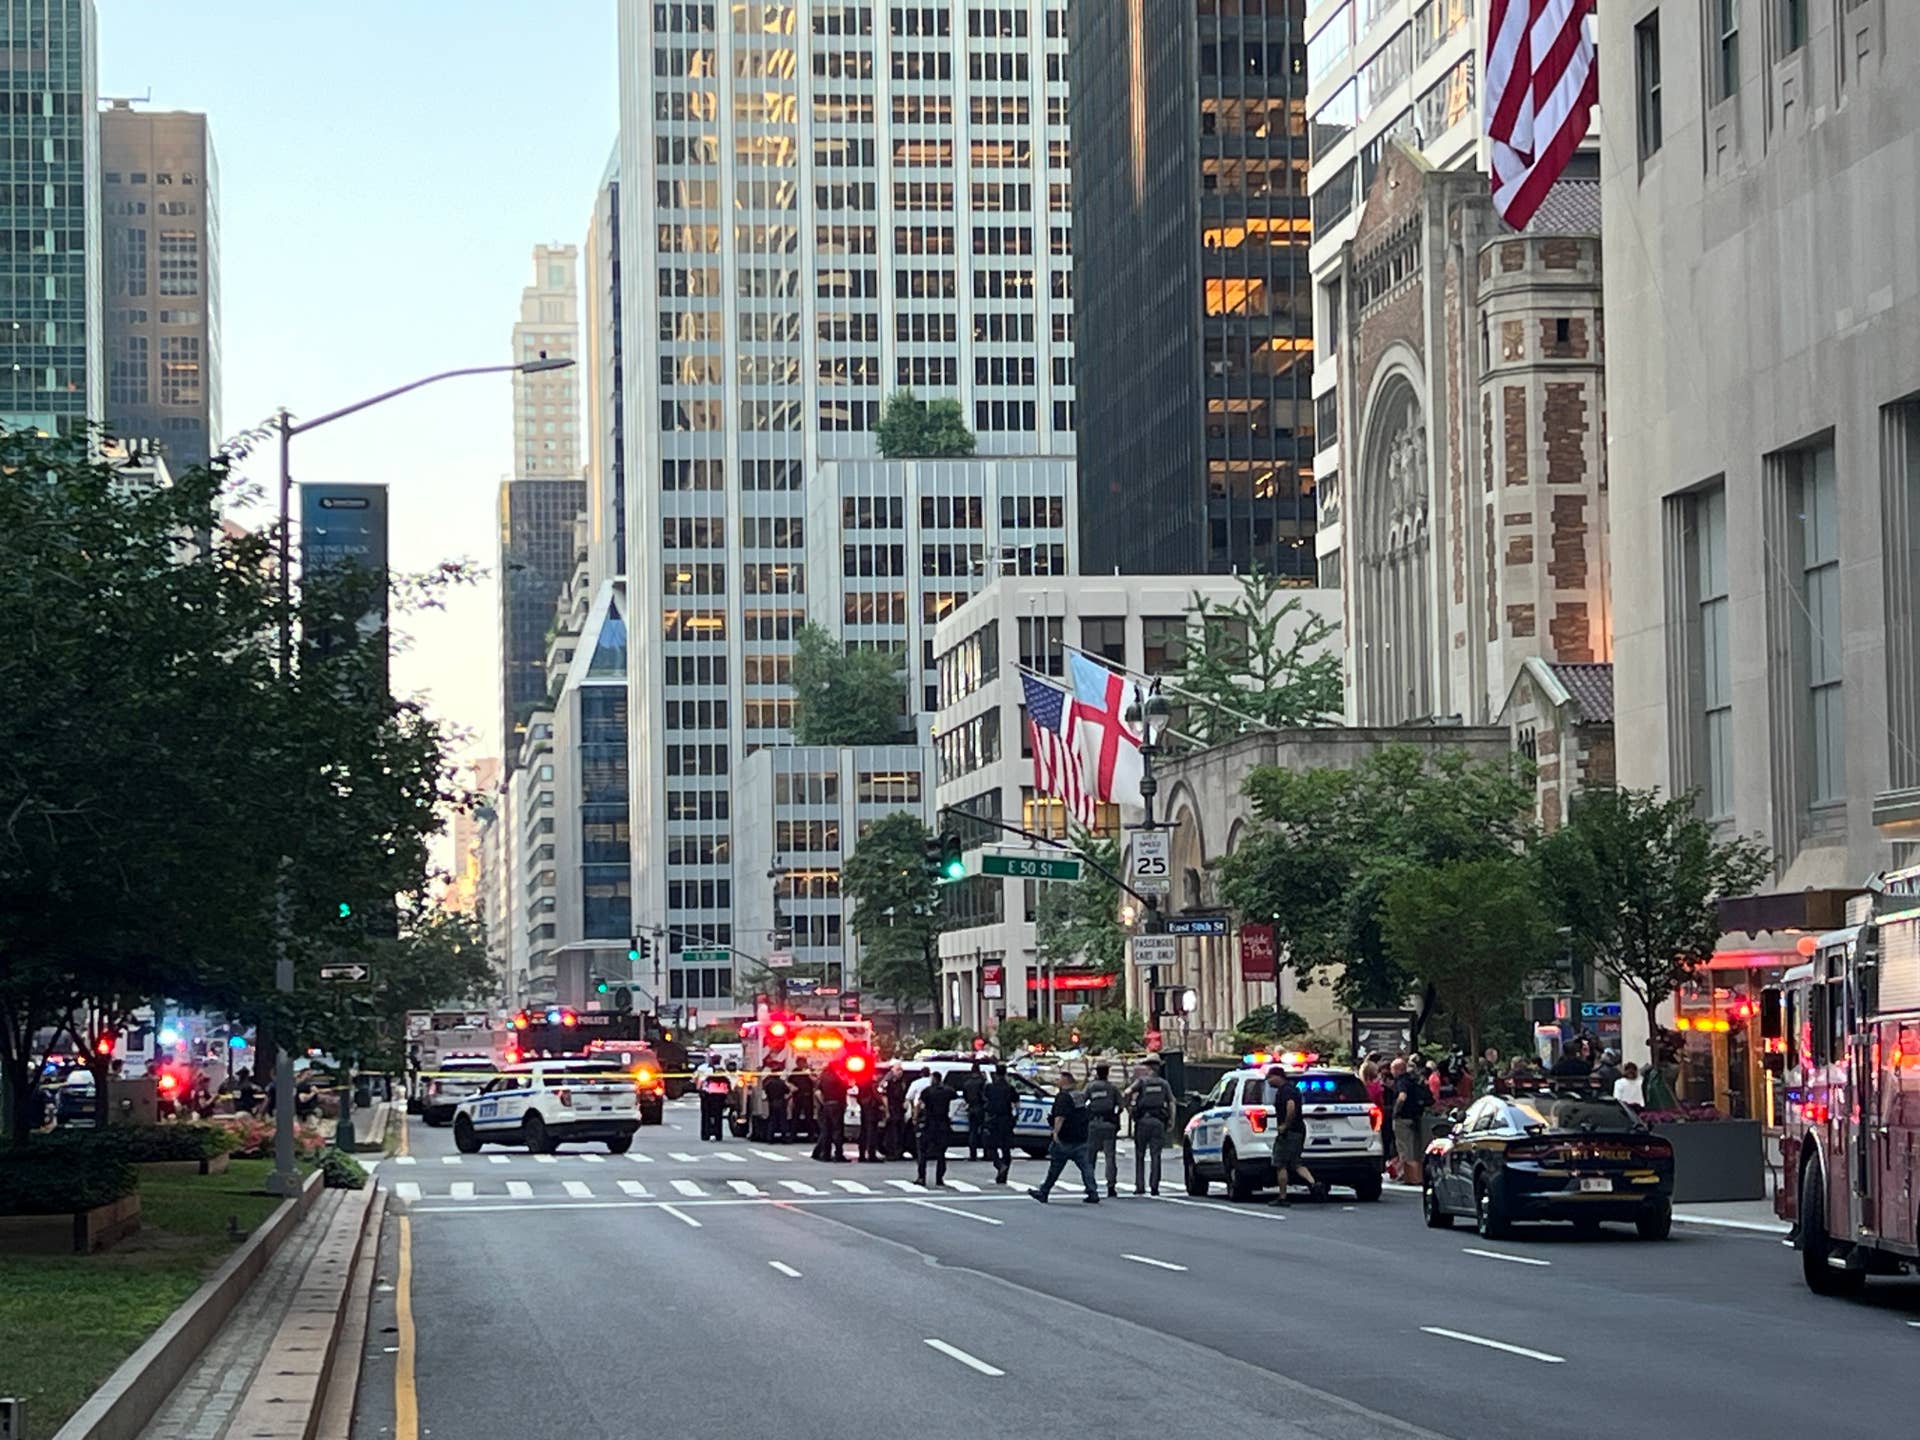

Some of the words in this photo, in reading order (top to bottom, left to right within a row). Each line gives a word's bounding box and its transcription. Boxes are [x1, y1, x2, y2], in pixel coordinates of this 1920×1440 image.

[1008, 860, 1017, 874] E
[1020, 861, 1037, 875] 50
[1040, 862, 1054, 876] St
[1137, 857, 1166, 874] 25
[1168, 922, 1190, 932] East
[1213, 921, 1225, 931] St
[1135, 938, 1174, 947] PASSENGER
[577, 1015, 610, 1025] POLICE
[1599, 1150, 1632, 1160] POLICE
